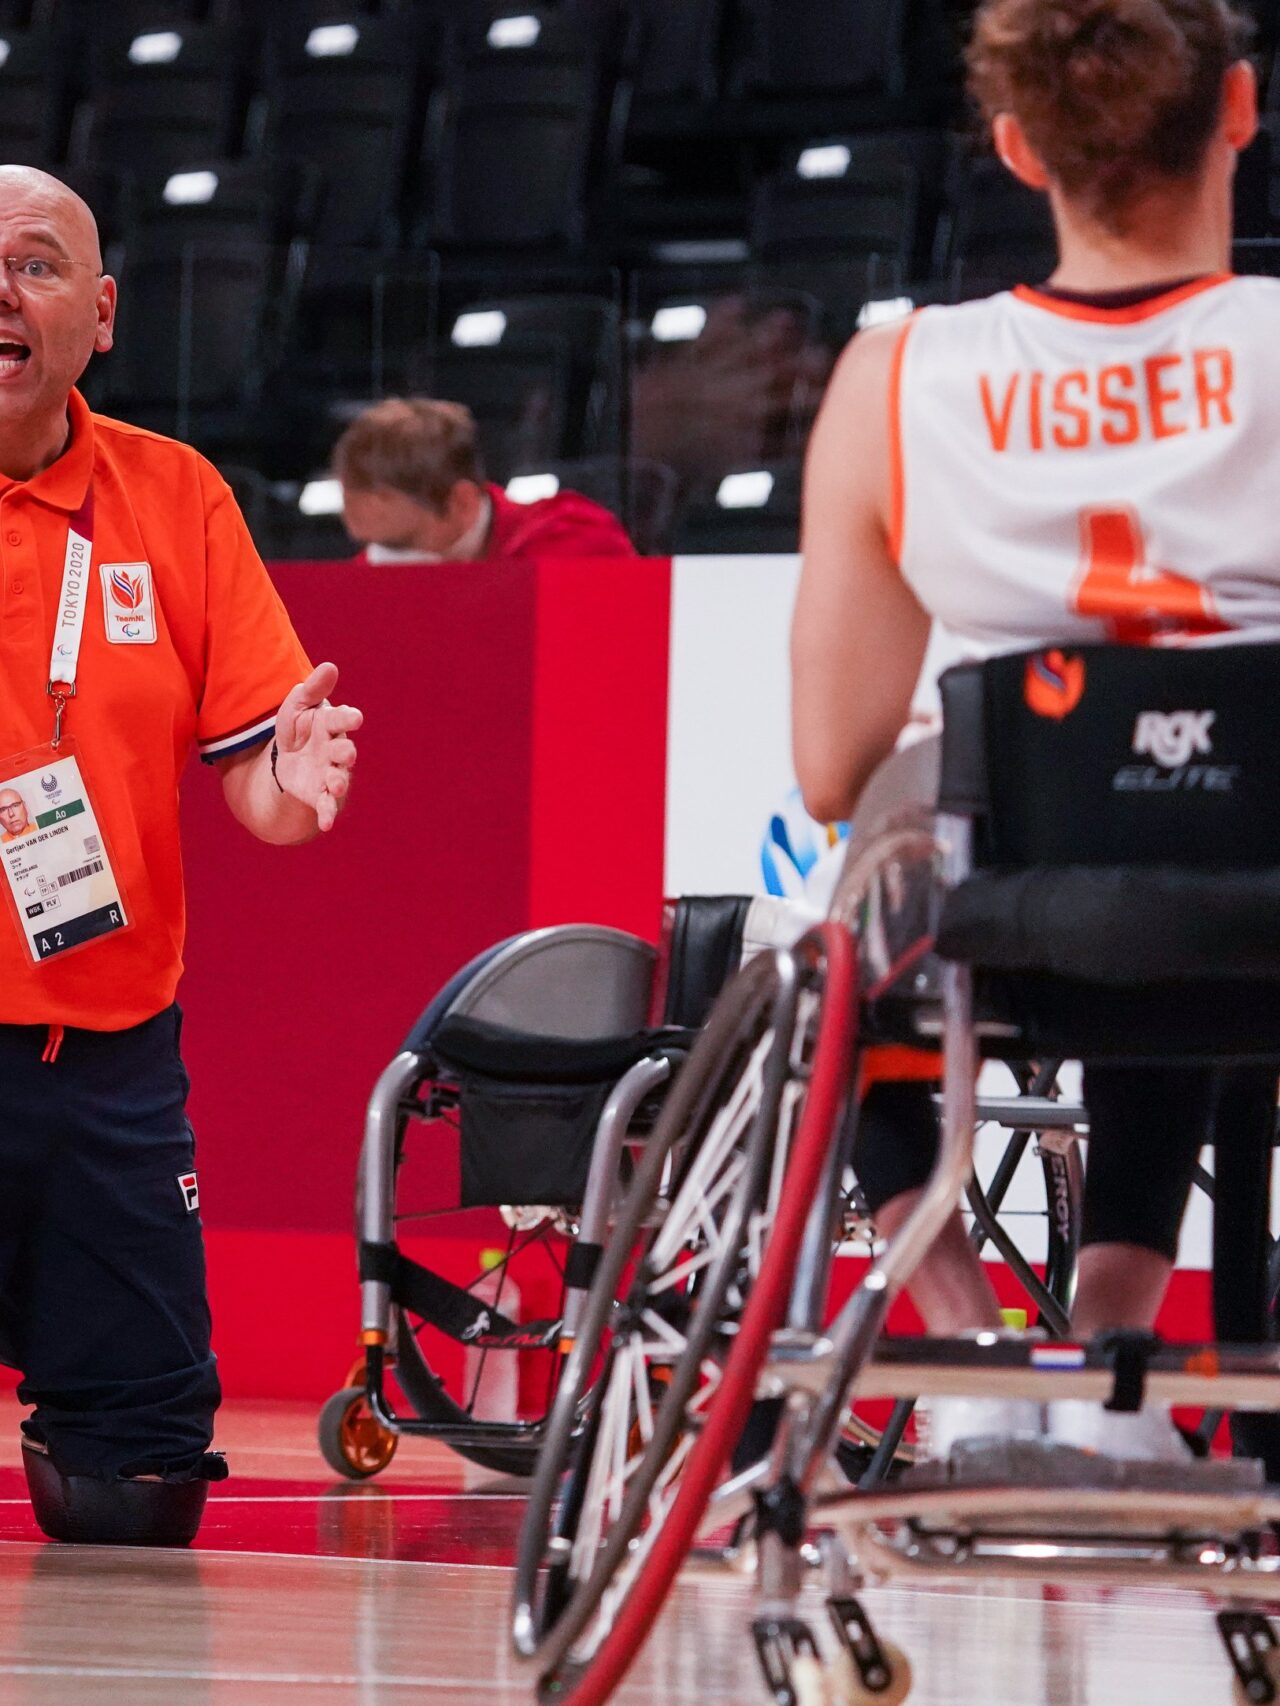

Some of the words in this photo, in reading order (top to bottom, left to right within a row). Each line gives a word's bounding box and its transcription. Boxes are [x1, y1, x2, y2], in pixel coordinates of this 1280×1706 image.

[977, 346, 1238, 455] VISSER
[68, 542, 85, 578] 2020
[62, 580, 80, 628] TOKYO
[6, 844, 25, 855] Gertjan
[25, 838, 38, 847] VAN
[37, 833, 49, 842] DER
[49, 825, 69, 838] LINDEN
[41, 937, 51, 952] A
[54, 932, 64, 946] 2
[109, 909, 119, 924] R
